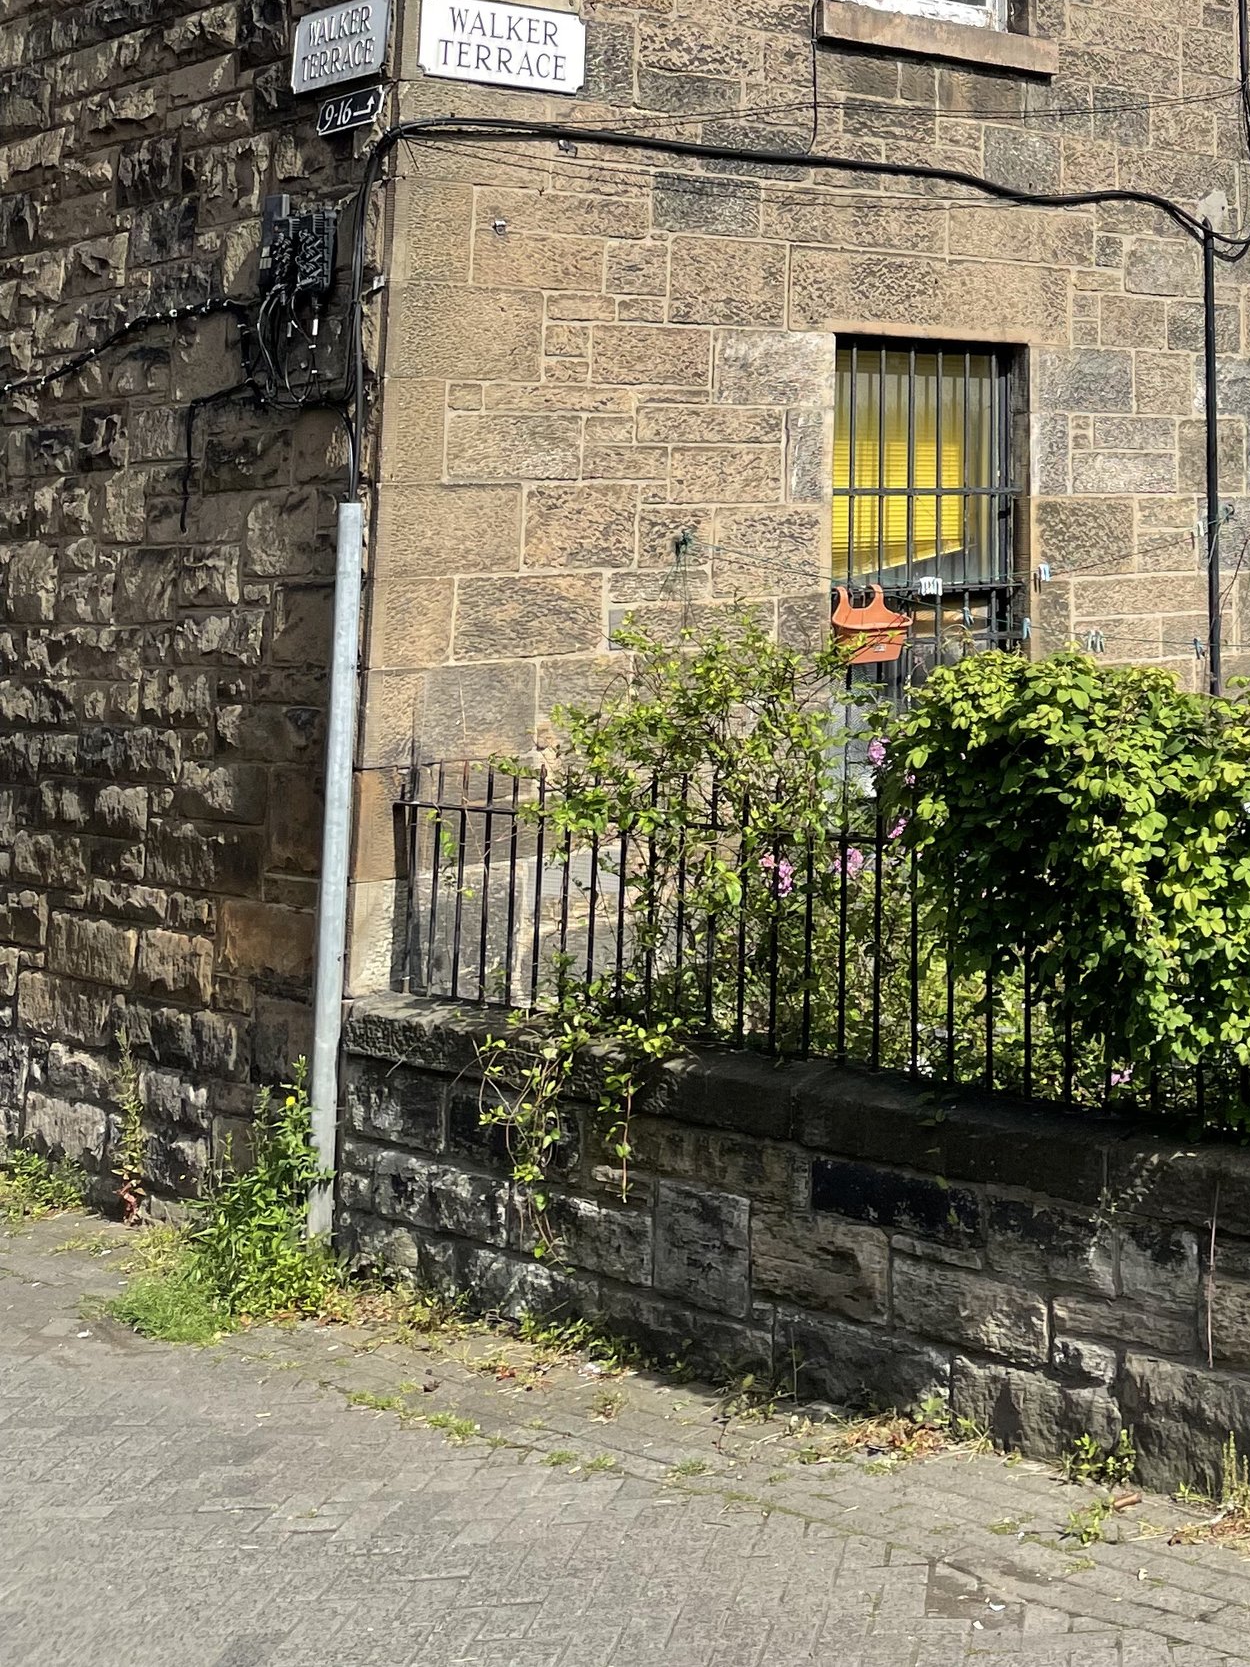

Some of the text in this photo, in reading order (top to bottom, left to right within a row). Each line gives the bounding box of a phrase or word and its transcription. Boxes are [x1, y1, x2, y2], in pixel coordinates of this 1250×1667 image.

[309, 5, 373, 47] WALKER
[449, 6, 559, 47] WALKER
[301, 36, 376, 82] TERRACE
[439, 39, 567, 81] TERRACE
